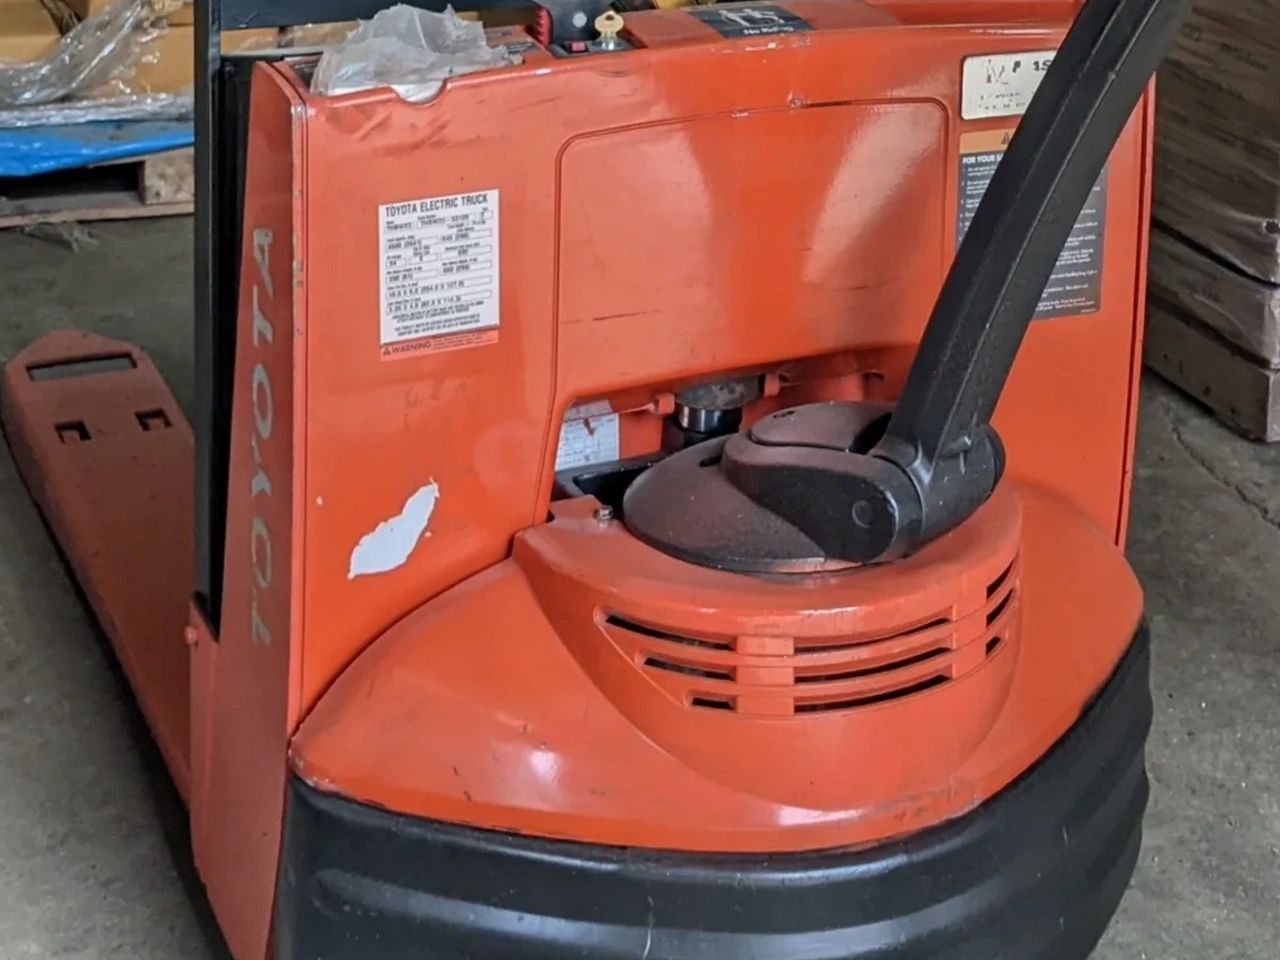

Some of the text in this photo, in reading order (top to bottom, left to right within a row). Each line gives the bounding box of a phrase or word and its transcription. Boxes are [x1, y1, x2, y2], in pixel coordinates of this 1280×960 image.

[977, 154, 995, 163] YOUR
[385, 193, 488, 218] TOYOTA ELECTRIC TRUCK
[392, 340, 433, 354] WARNING
[252, 228, 274, 648] TOYOTA
